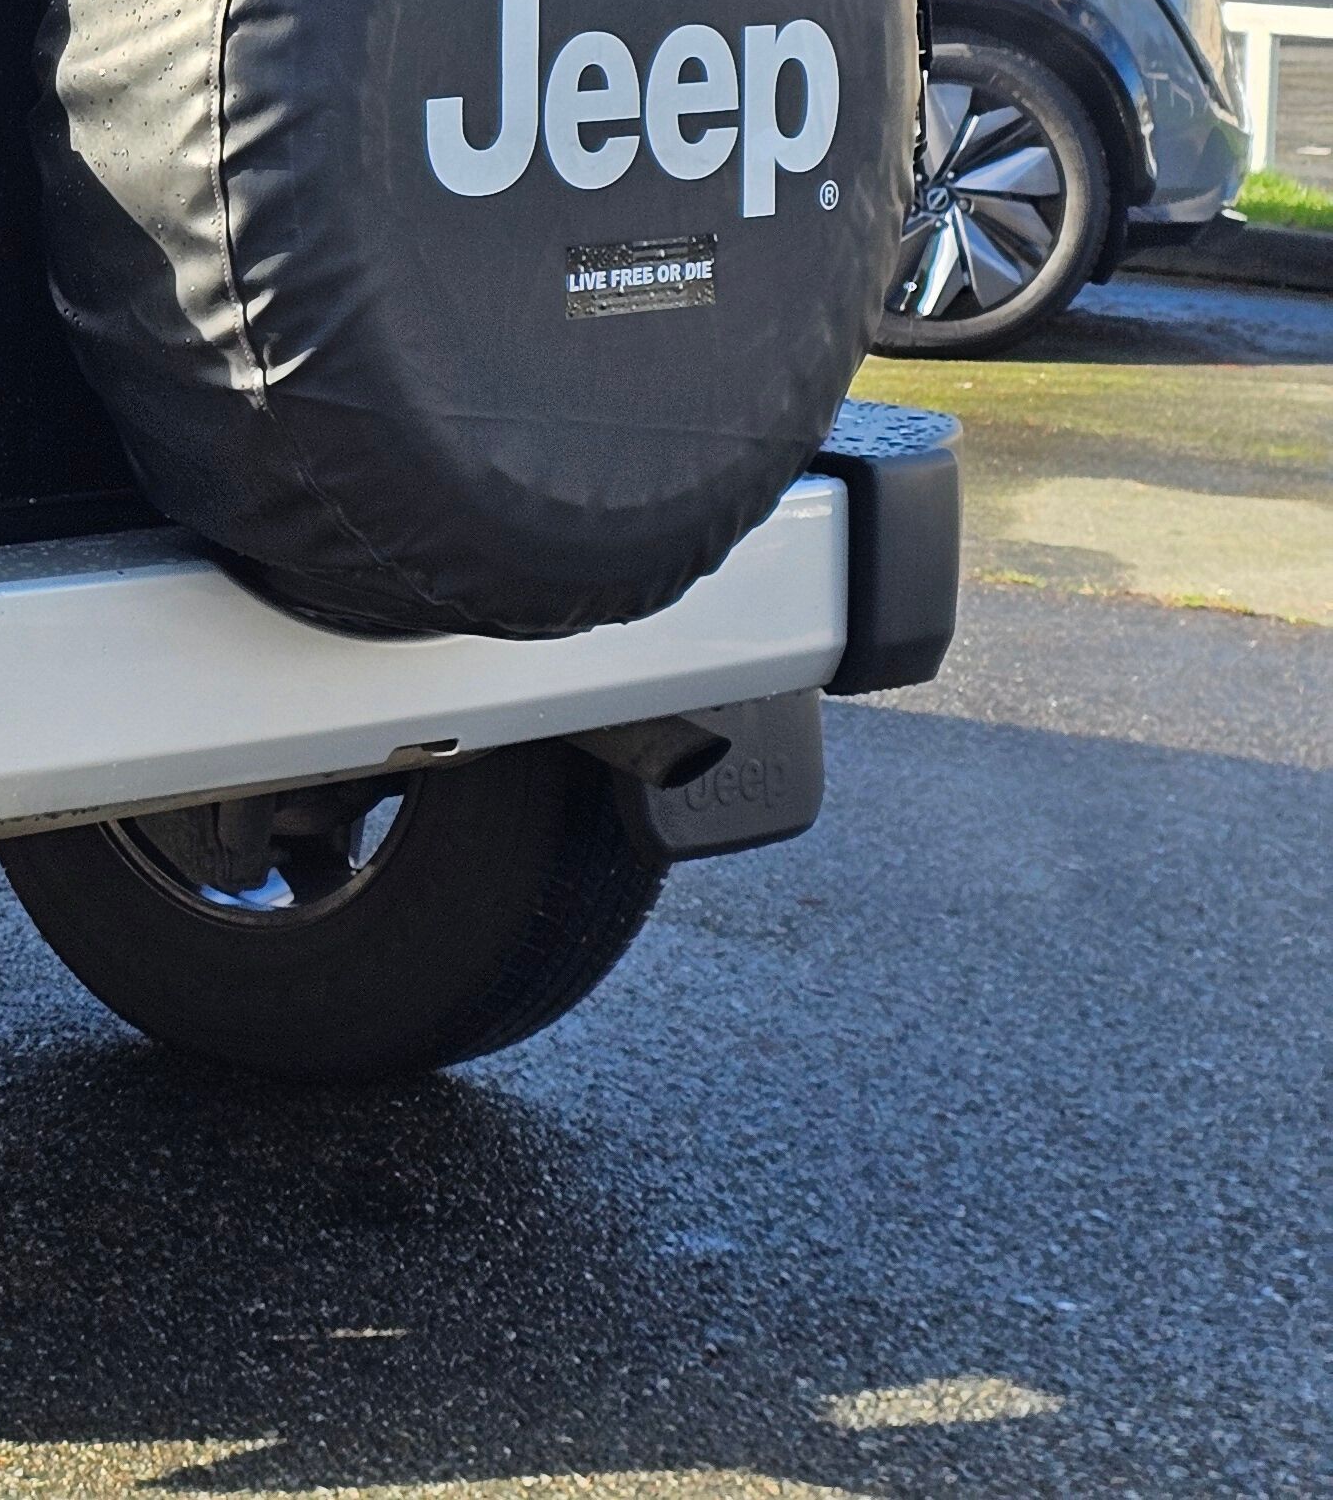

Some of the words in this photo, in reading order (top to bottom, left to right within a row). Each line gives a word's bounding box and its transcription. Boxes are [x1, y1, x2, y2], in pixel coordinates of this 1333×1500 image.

[569, 271, 607, 292] LIVE
[611, 267, 654, 288] FREE
[657, 264, 681, 283] OR
[685, 261, 713, 281] DIE
